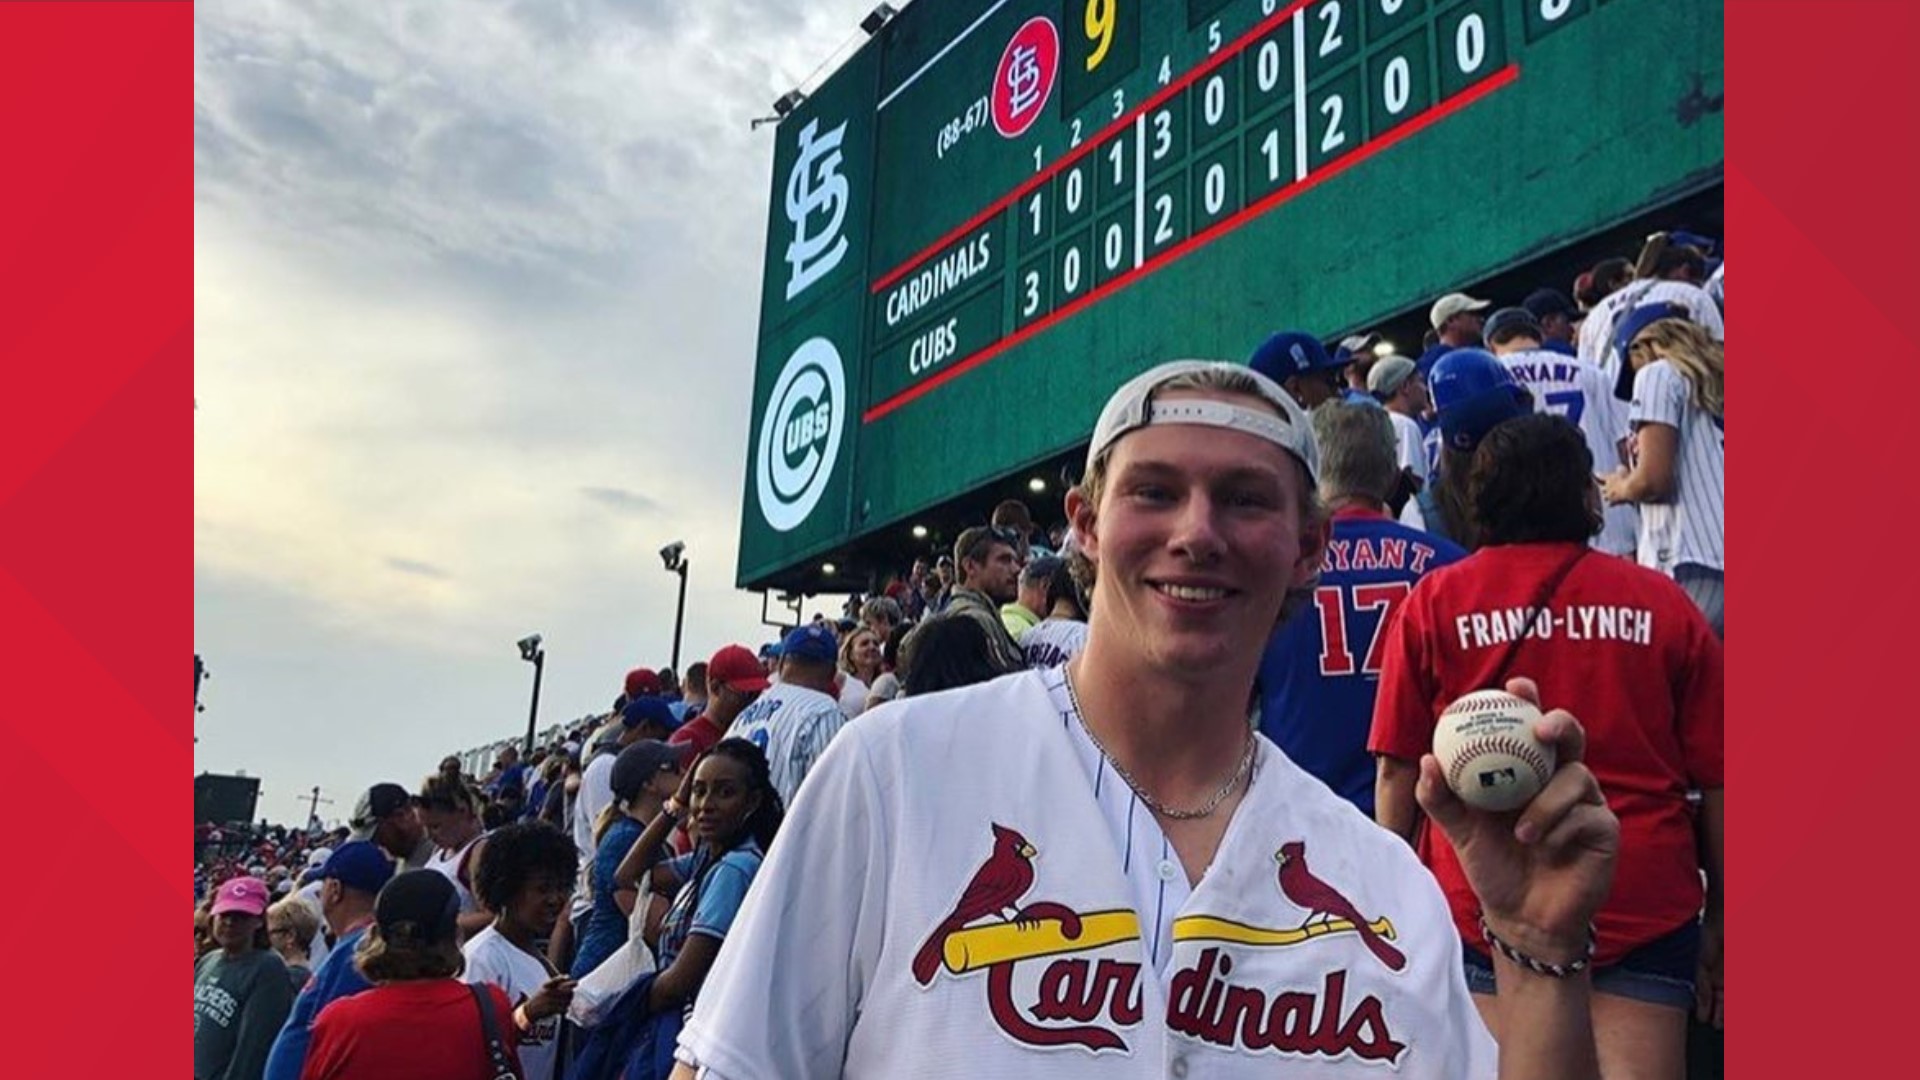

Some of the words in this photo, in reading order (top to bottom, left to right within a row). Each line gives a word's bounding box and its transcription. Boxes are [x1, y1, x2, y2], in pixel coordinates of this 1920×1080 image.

[1085, 0, 1115, 71] 9
[938, 95, 989, 159] (88-67)
[1033, 145, 1042, 172] 1
[1070, 119, 1082, 149] 2
[1112, 88, 1125, 120] 3
[1157, 54, 1172, 85] 4
[1208, 20, 1222, 54] 5
[886, 232, 990, 326] CARDINALS
[1029, 192, 1042, 236] 1
[1066, 167, 1083, 214] 0
[1109, 139, 1123, 185] 1
[1153, 109, 1172, 160] 3
[1204, 75, 1225, 126] 0
[1257, 40, 1280, 92] 0
[1318, 0, 1343, 58] 2
[909, 317, 958, 375] CUBS
[1023, 270, 1040, 317] 3
[1063, 246, 1081, 294] 0
[1104, 222, 1123, 271] 0
[1153, 193, 1173, 246] 2
[1204, 163, 1226, 215] 0
[1260, 128, 1279, 182] 1
[1320, 94, 1345, 153] 2
[1383, 56, 1410, 115] 0
[1456, 13, 1485, 74] 0
[1508, 363, 1581, 384] RYANT
[1313, 581, 1411, 676] 17
